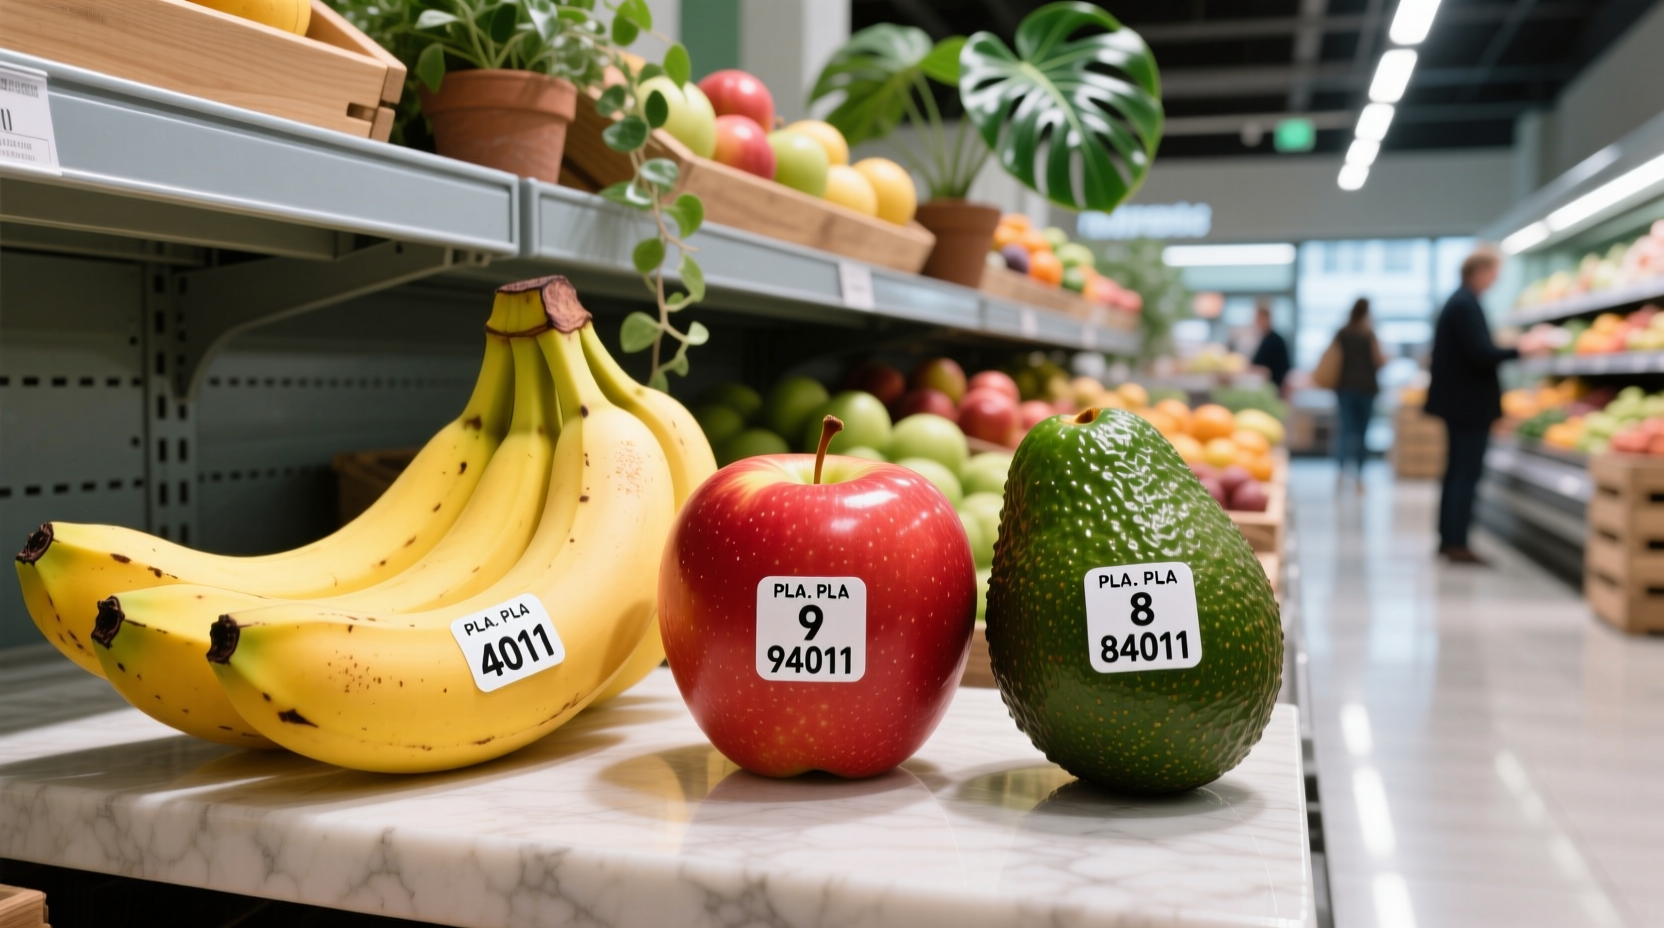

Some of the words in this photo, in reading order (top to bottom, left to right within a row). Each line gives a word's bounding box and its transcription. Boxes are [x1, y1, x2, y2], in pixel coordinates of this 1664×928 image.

[773, 583, 812, 599] PLA.
[816, 583, 850, 600] PLA
[1098, 572, 1138, 589] PLA.
[1143, 569, 1178, 586] PLA
[499, 603, 530, 623] PLA
[798, 604, 824, 641] 9
[1130, 591, 1155, 627] 8
[481, 623, 555, 677] 4011
[767, 645, 852, 675] 94011
[1100, 630, 1189, 664] 84011
